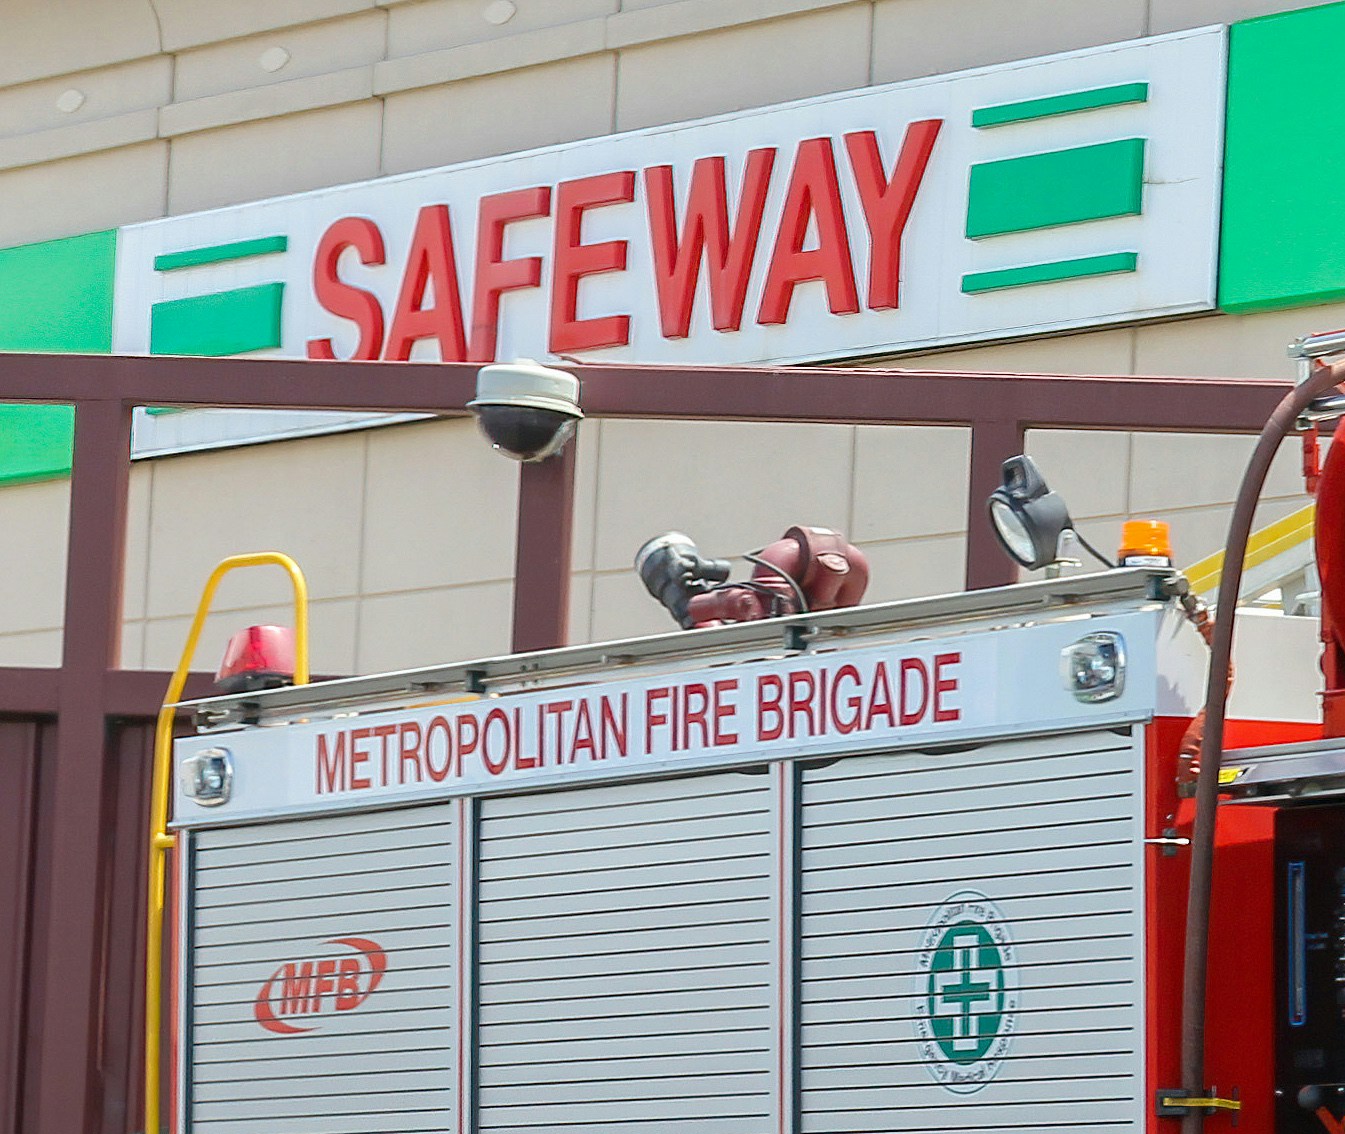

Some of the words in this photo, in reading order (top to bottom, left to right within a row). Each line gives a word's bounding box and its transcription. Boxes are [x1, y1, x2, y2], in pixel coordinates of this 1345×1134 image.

[307, 119, 943, 363] SAFEWAY
[315, 692, 628, 796] METROPOLITAN
[644, 678, 740, 755] FIRE
[757, 652, 962, 742] BRIGADE
[279, 959, 361, 1015] MFB
